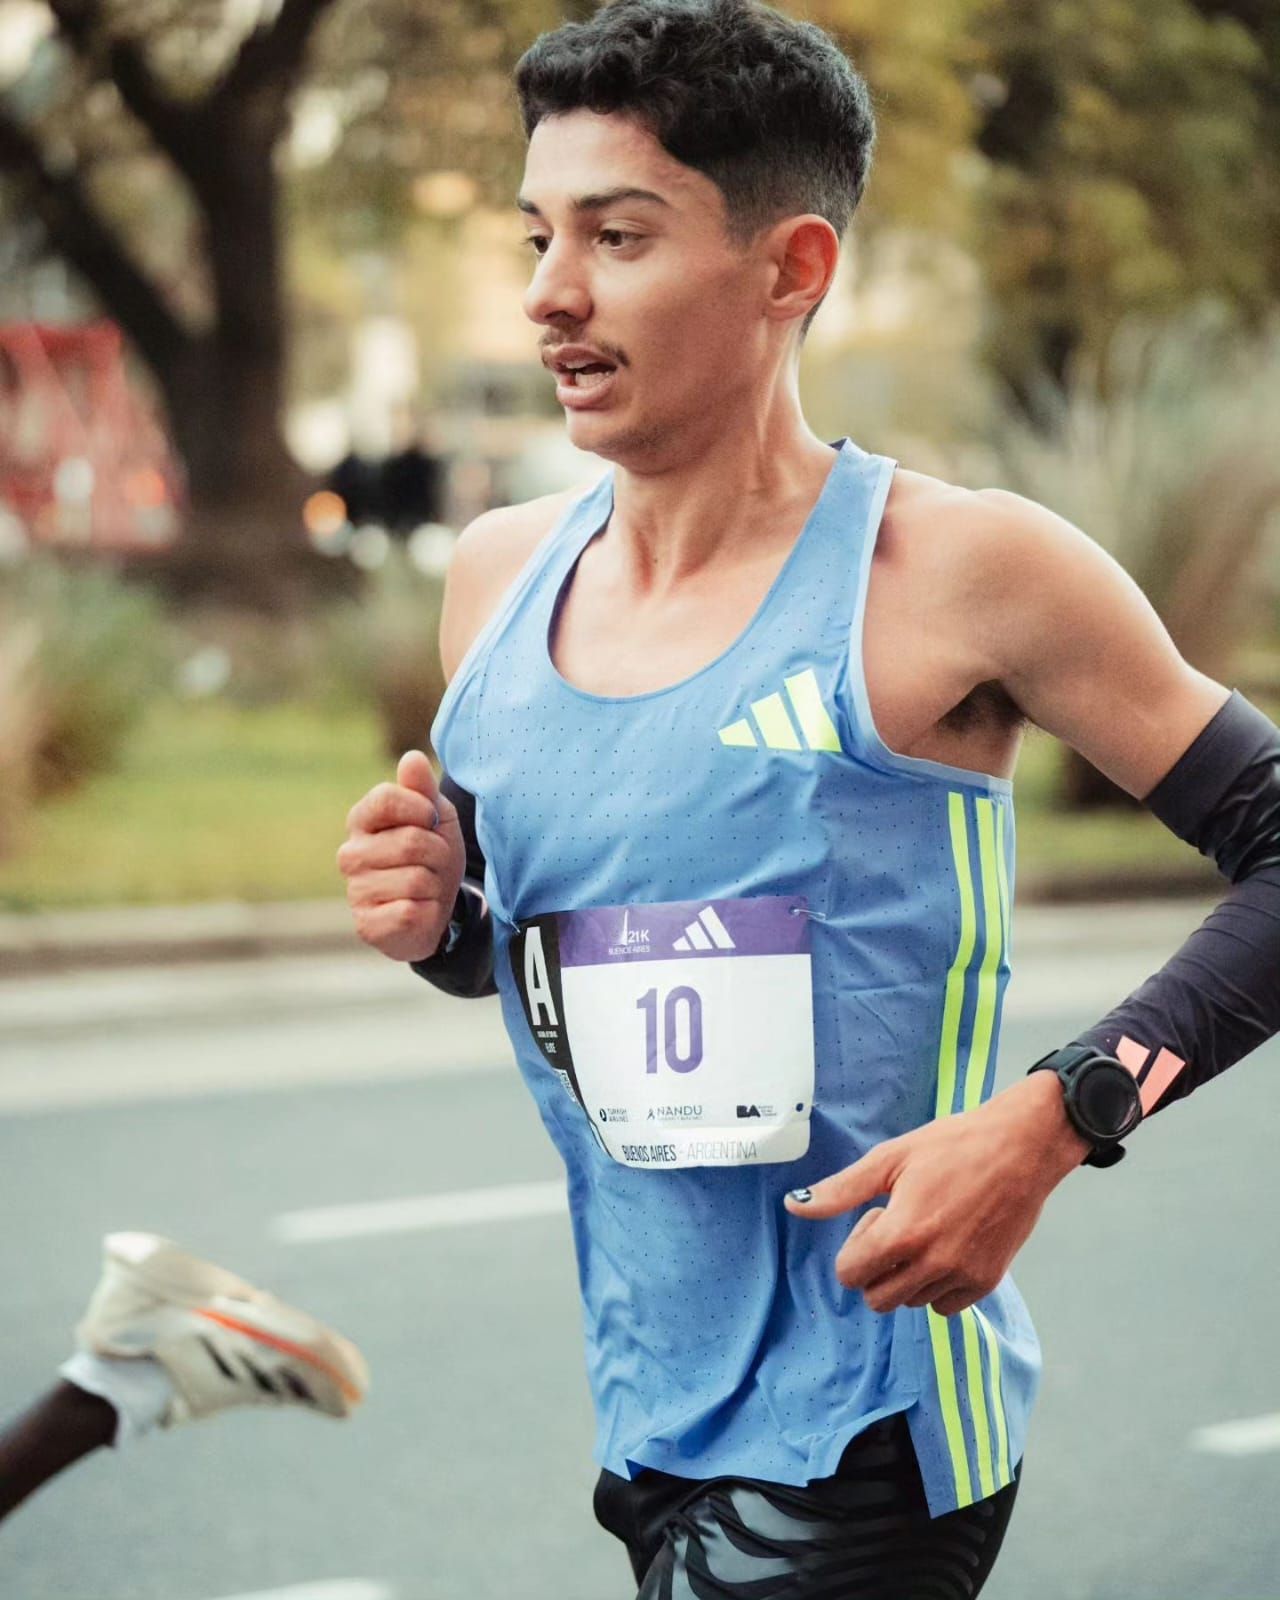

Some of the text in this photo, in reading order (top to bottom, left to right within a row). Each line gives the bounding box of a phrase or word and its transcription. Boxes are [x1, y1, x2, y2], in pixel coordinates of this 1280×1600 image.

[628, 929, 650, 943] 21K
[524, 926, 559, 1026] A
[636, 985, 704, 1074] 10
[736, 1104, 761, 1118] BA
[621, 1144, 650, 1162] BUENOS
[650, 1144, 677, 1162] AIRES
[687, 1141, 758, 1160] ARGENTINA
